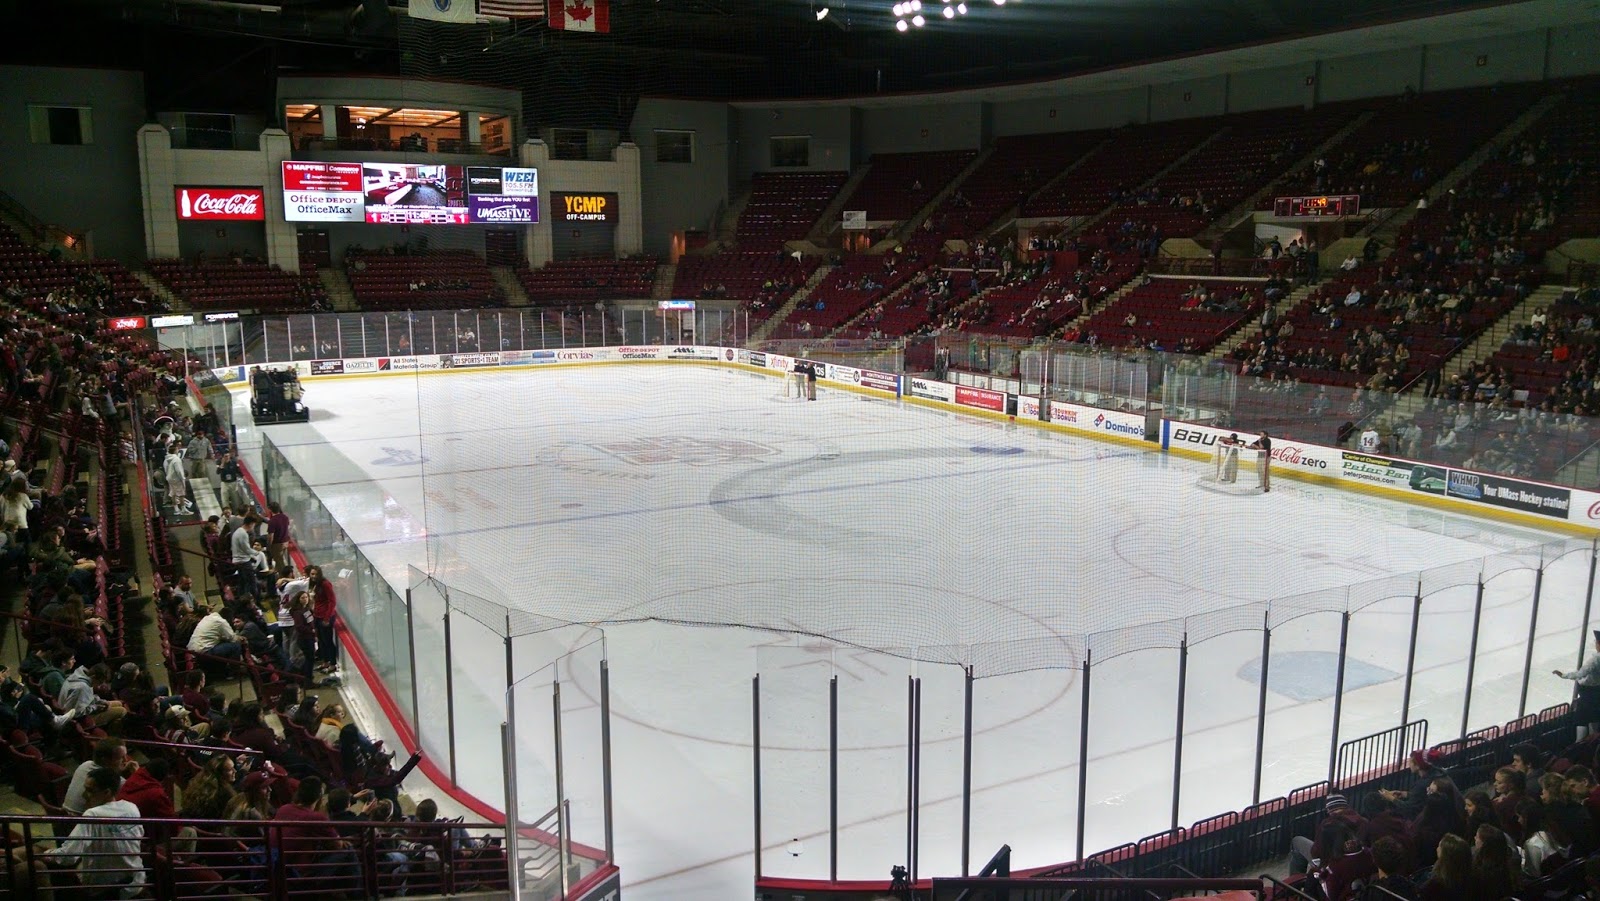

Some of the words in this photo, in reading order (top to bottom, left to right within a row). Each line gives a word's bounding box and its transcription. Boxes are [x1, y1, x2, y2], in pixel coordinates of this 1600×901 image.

[505, 172, 535, 182] WEEI
[194, 193, 260, 214] Coca-Cola
[290, 195, 324, 203] Office
[564, 196, 606, 213] YCMP
[298, 205, 353, 214] OfficeMax
[557, 350, 594, 360] Corvias
[960, 389, 978, 397] MAPFRE
[1105, 420, 1145, 436] Domino's
[1364, 437, 1374, 446] 14
[1302, 457, 1327, 468] zero
[1342, 462, 1382, 474] Peter
[1385, 470, 1409, 480] Pan
[1344, 471, 1396, 485] peterpanbus.com
[1452, 472, 1480, 488] WHMP
[1484, 484, 1497, 496] Your
[1498, 486, 1519, 500] UMass
[1520, 490, 1542, 508] Hockey
[1543, 497, 1569, 510] station!
